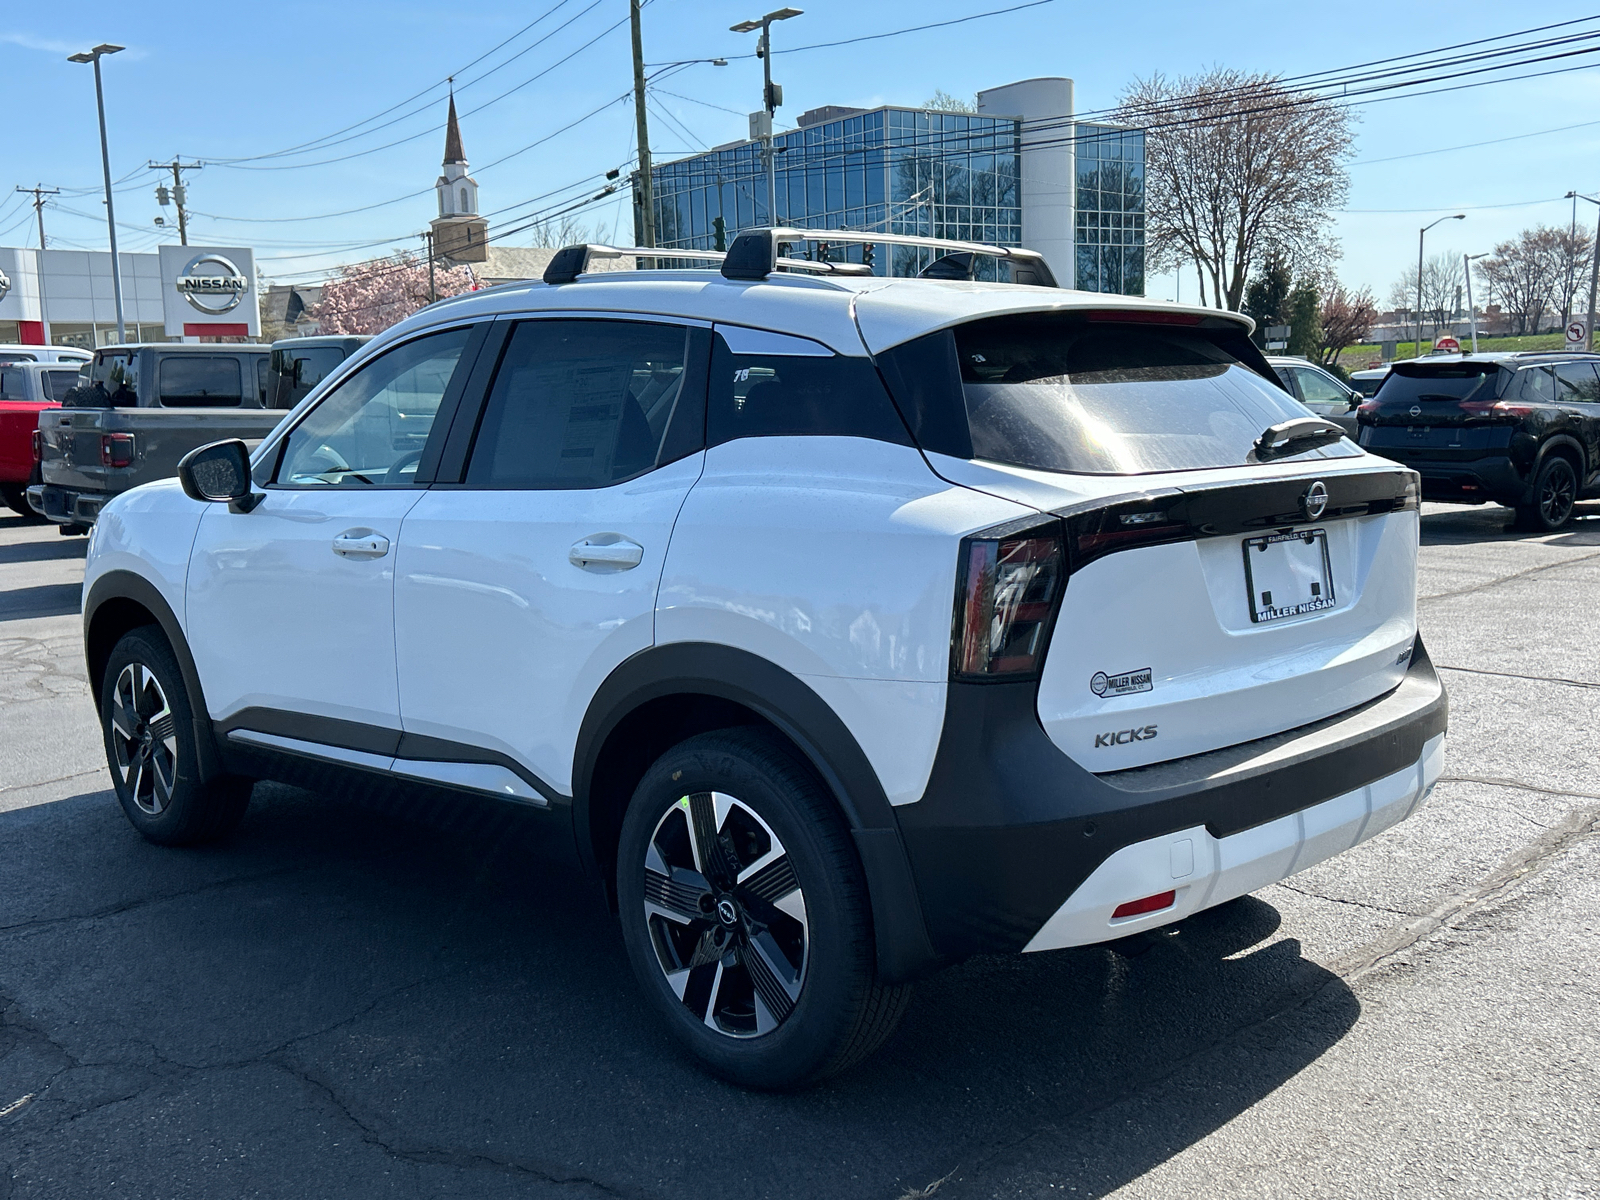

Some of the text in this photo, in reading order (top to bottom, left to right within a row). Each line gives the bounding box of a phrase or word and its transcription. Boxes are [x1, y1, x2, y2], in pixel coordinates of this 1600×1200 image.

[185, 279, 243, 289] NISSAN
[1257, 598, 1335, 622] MILLER NISSAN
[1108, 673, 1151, 689] MILLER NISSAN
[1094, 723, 1158, 748] KICKS
